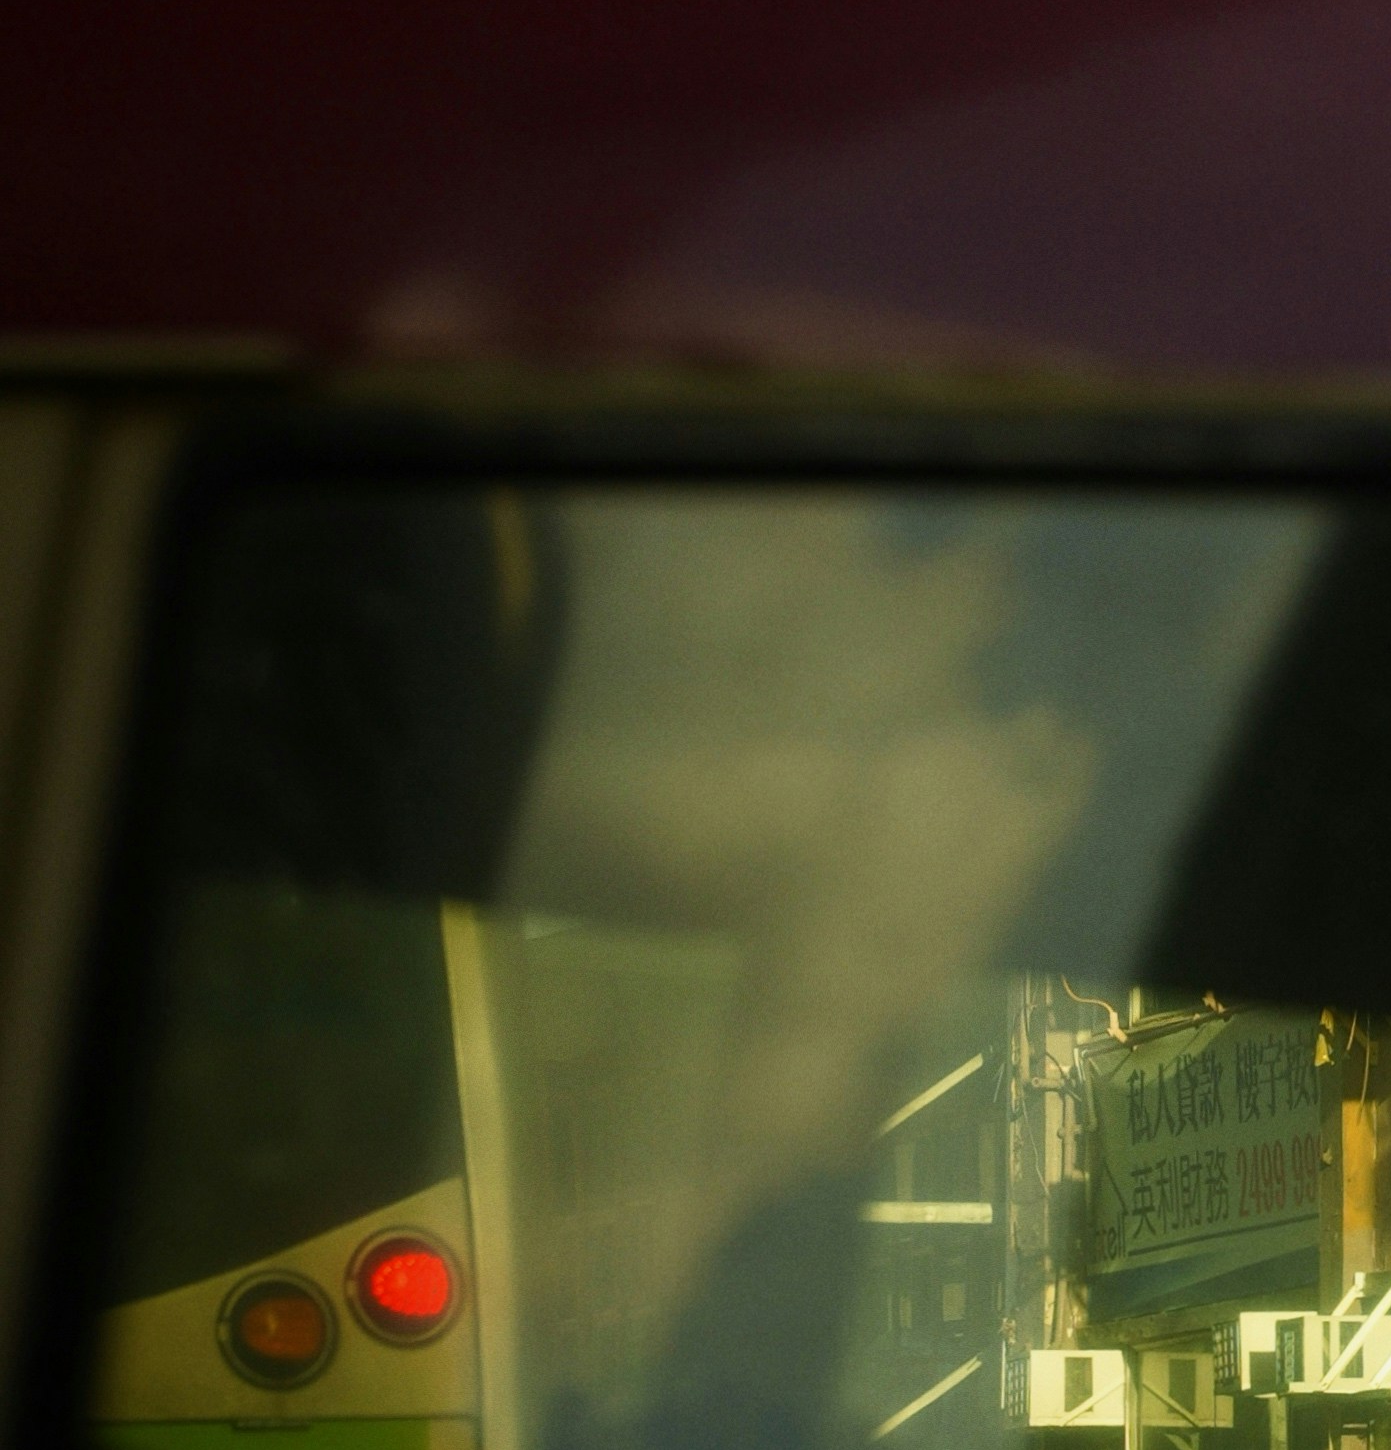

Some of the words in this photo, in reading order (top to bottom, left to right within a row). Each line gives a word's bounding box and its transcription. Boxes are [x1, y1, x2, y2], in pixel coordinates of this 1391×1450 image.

[1125, 1049, 1225, 1146] 私人貸款
[1130, 1148, 1231, 1239] 英利財務
[1236, 1137, 1287, 1217] 2499
